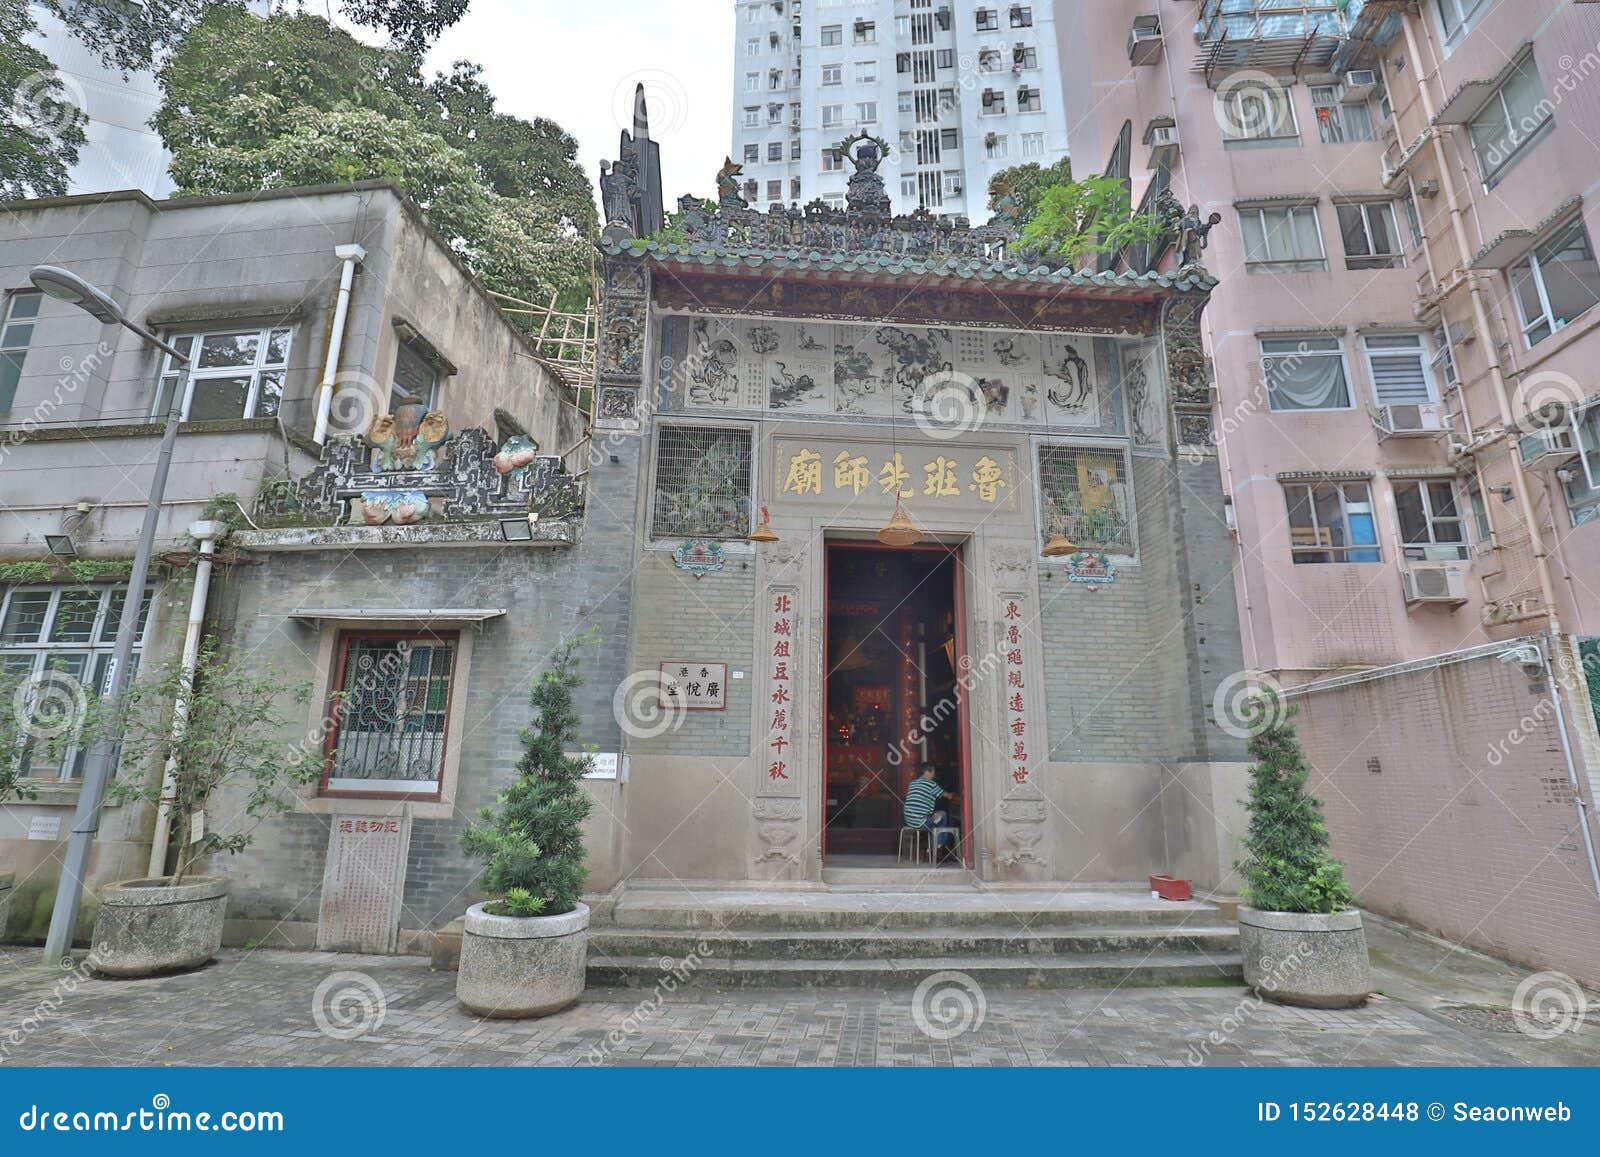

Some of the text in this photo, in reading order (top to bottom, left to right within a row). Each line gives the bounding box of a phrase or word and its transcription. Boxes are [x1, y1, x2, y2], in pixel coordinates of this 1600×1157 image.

[783, 448, 1006, 503] 魯班先師廟
